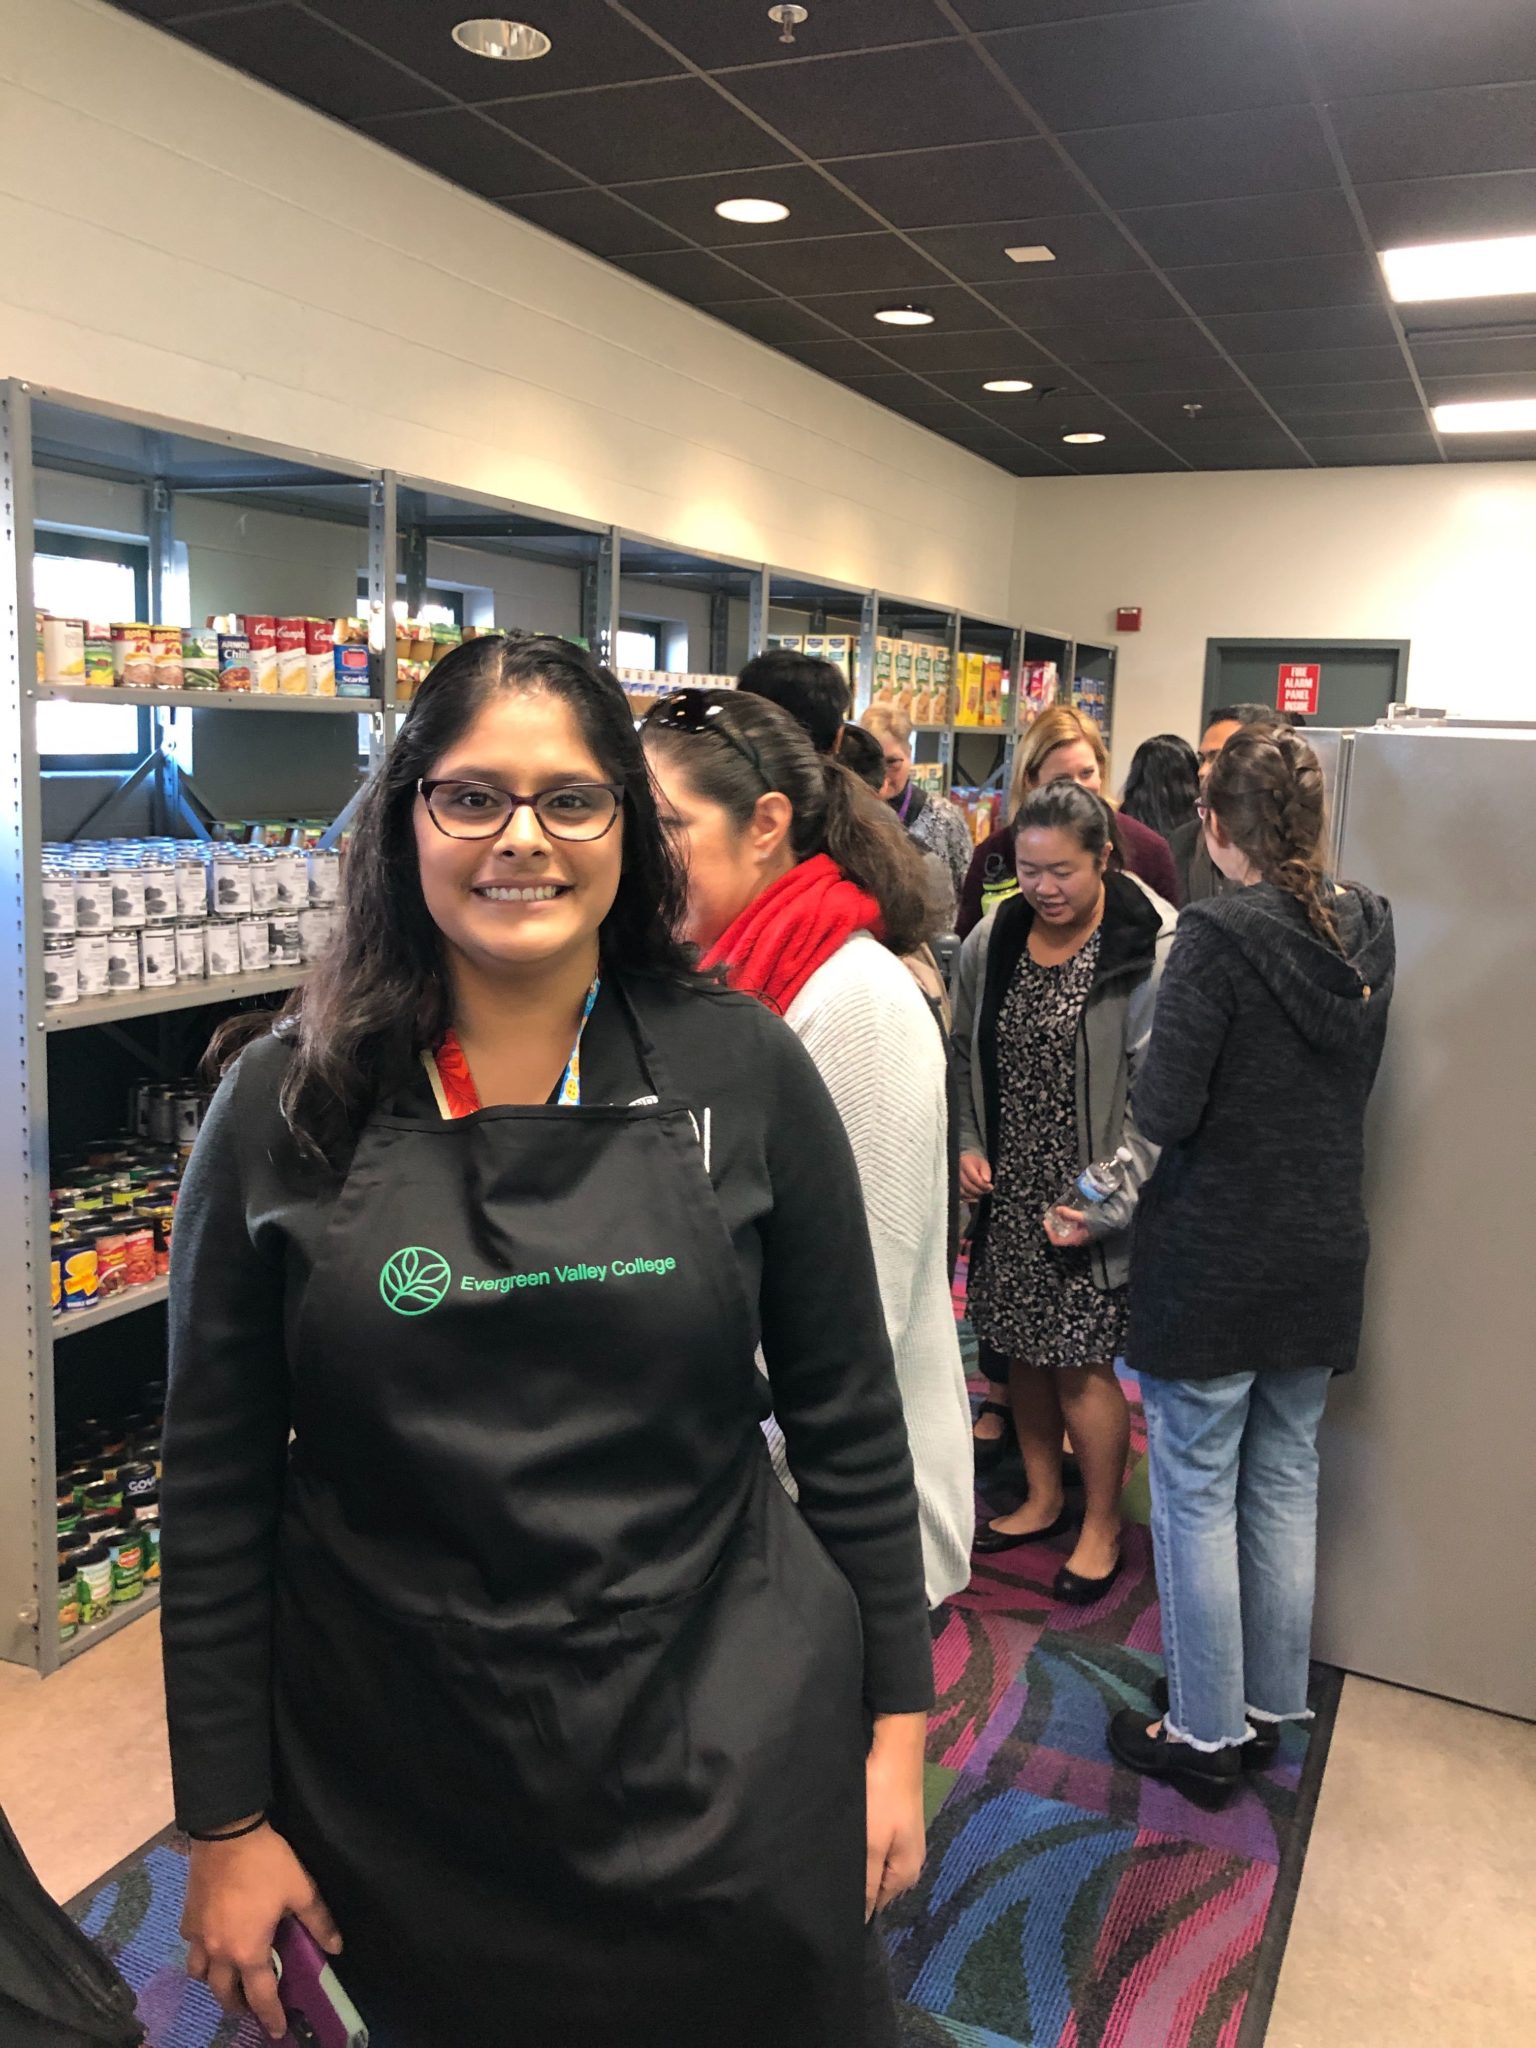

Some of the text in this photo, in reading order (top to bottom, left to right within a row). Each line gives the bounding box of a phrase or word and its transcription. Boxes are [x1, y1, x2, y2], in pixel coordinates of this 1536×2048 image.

[1291, 667, 1307, 677] FIRE
[1284, 678, 1313, 688] ALARM
[1285, 689, 1309, 699] PANEL
[460, 1256, 676, 1293] Evergreen Valley College
[128, 1476, 156, 1491] GOY
